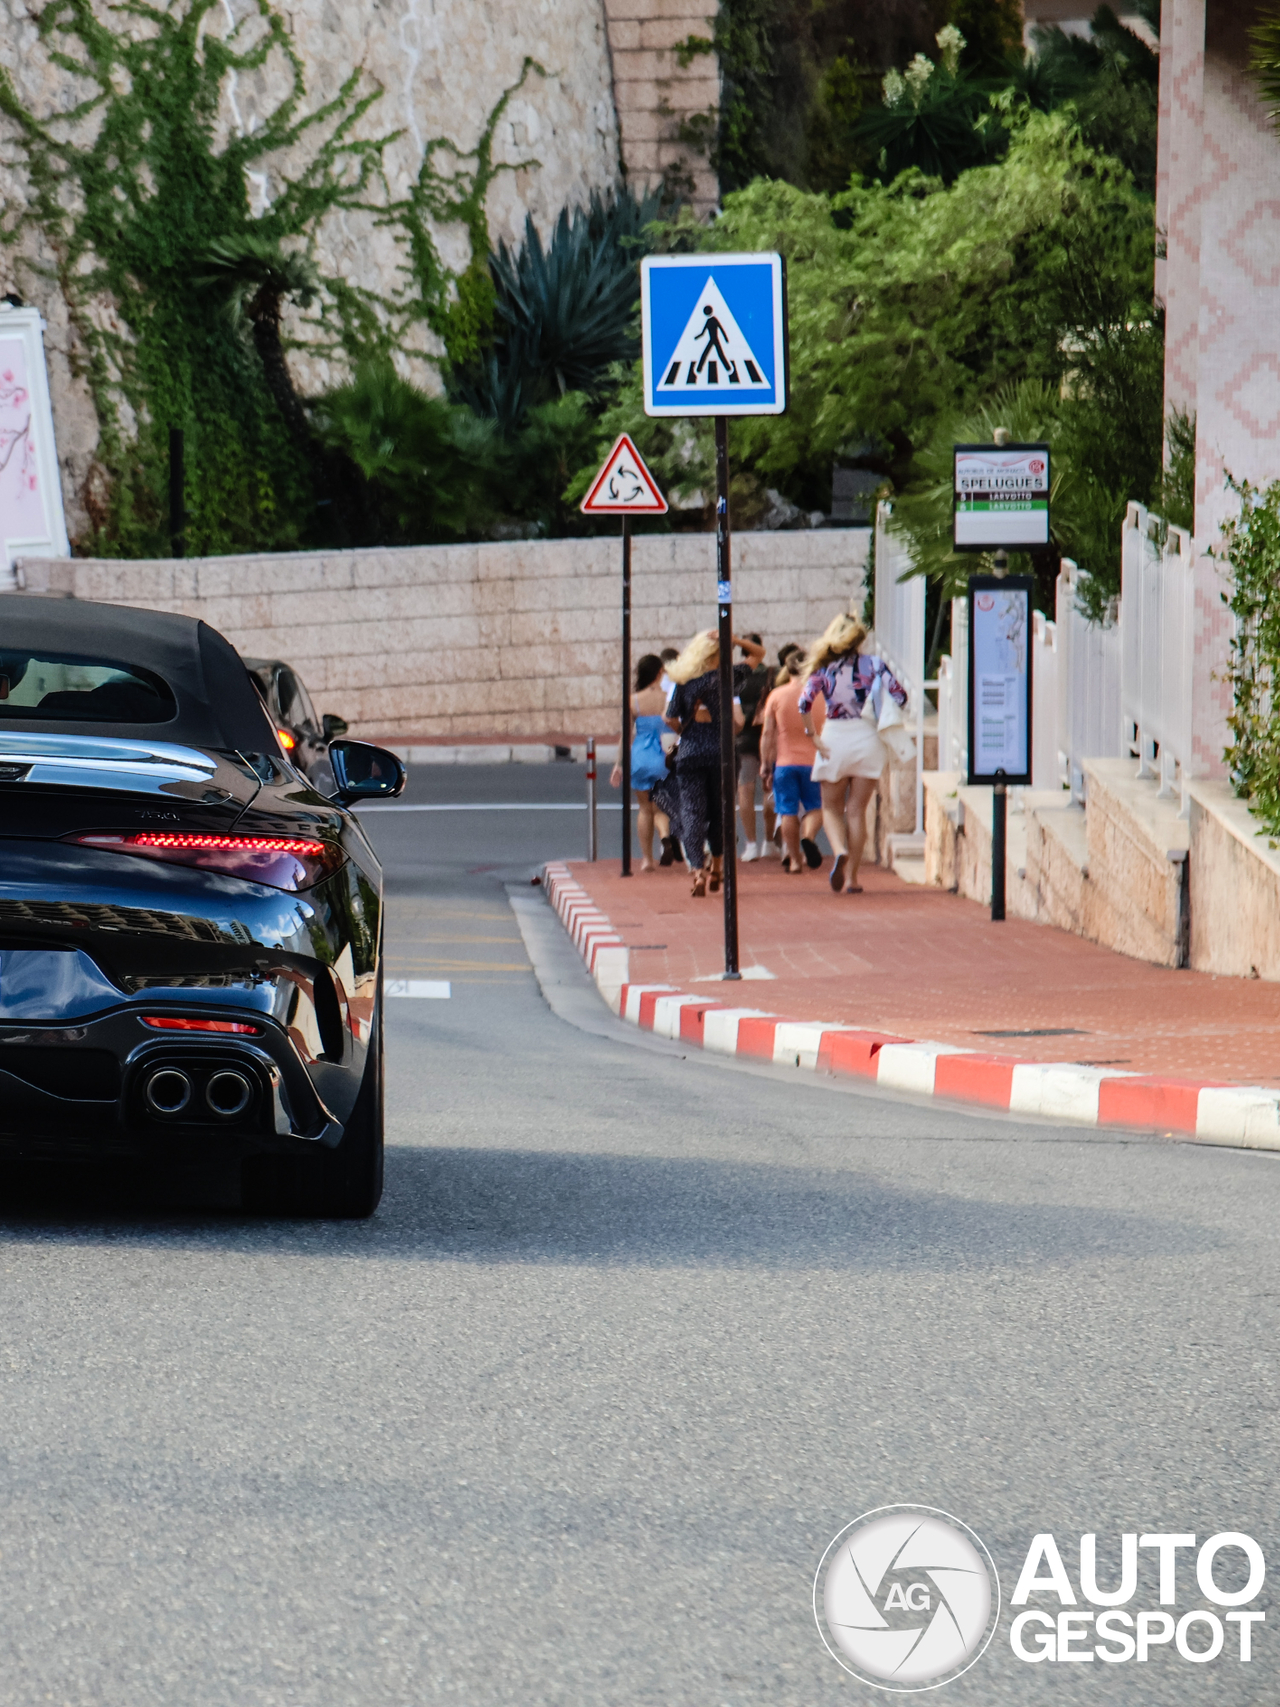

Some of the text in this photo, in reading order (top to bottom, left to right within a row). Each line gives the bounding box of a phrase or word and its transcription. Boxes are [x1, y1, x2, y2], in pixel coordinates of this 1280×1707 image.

[961, 476, 1043, 490] SPELUGUES
[989, 491, 1033, 501] LARVOTTO
[989, 502, 1033, 511] LARVOTTO
